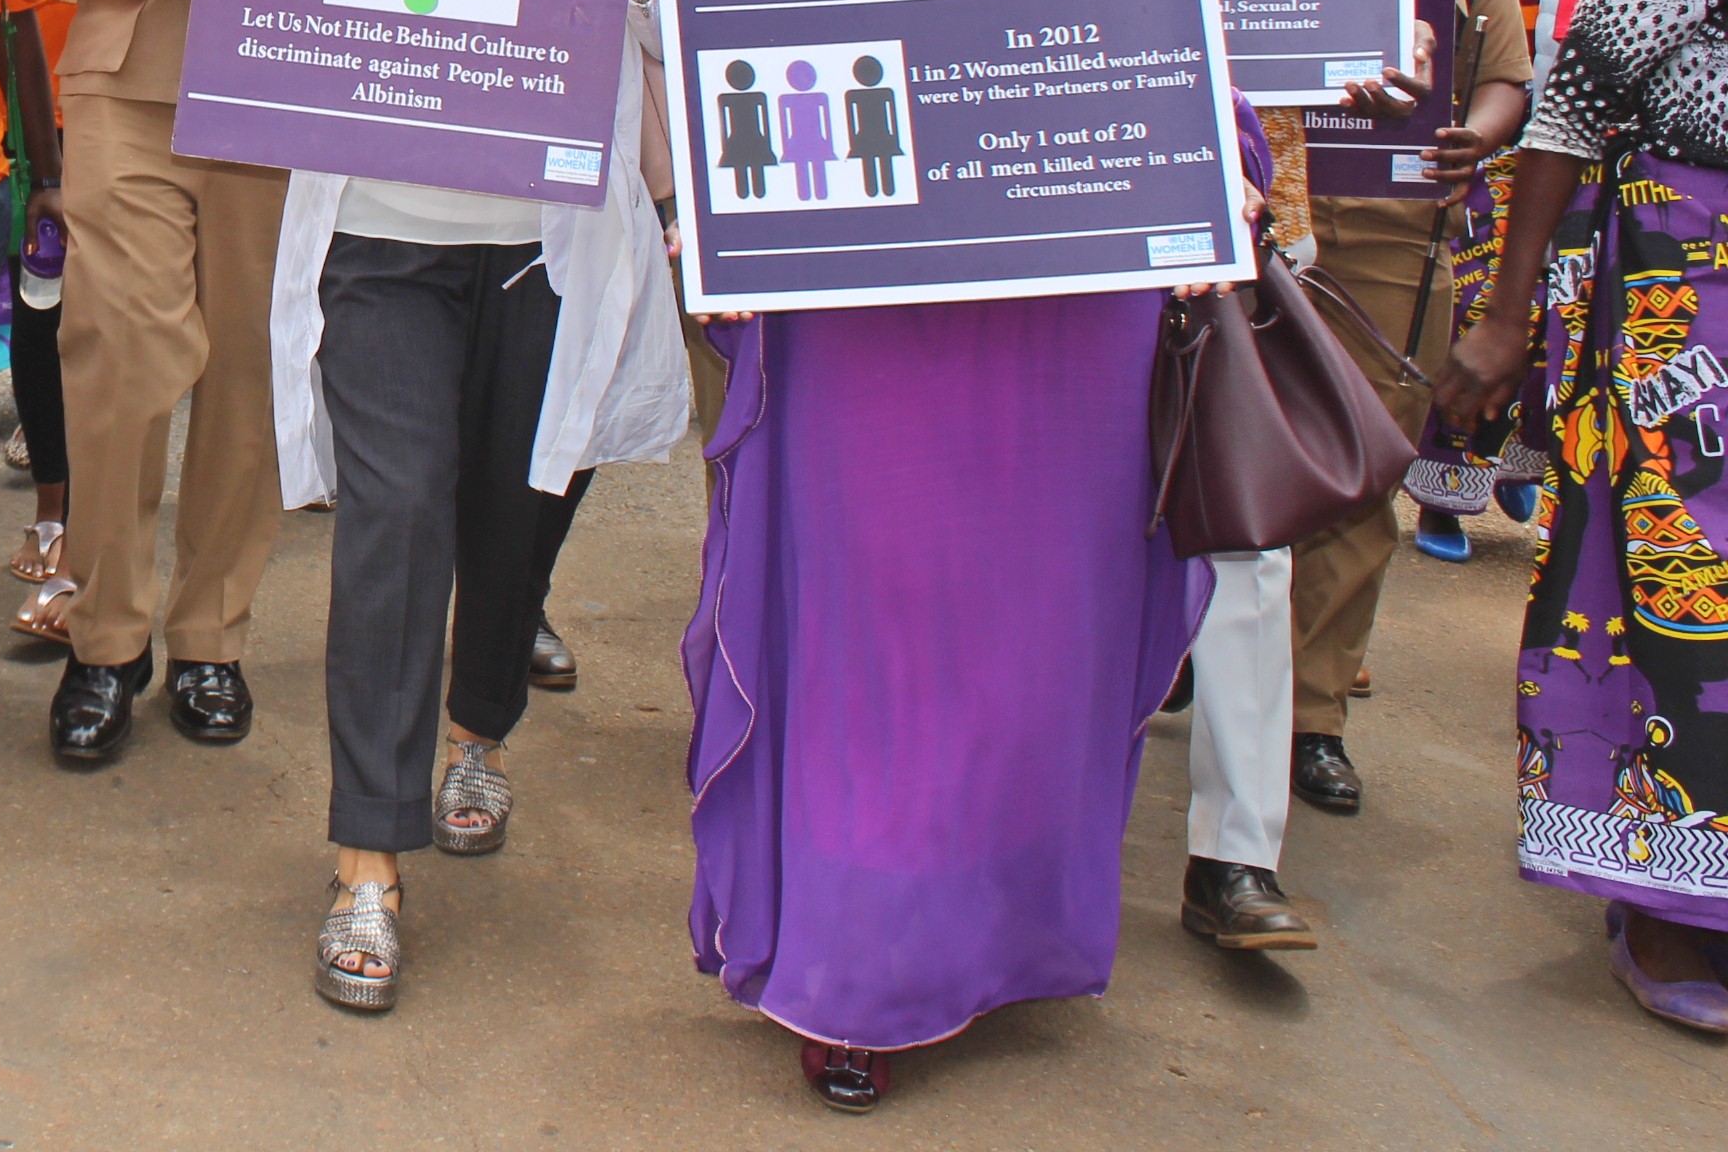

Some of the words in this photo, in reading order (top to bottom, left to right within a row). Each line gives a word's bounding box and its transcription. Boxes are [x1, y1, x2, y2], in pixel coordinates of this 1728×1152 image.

[1237, 0, 1298, 12] Sexual
[1299, 2, 1321, 11] or
[241, 7, 274, 29] Let
[278, 12, 303, 33] Us
[304, 14, 341, 37] Not
[343, 18, 393, 43] Hide
[396, 26, 467, 52] Behind
[470, 35, 546, 61] Culture
[549, 46, 569, 63] to
[1005, 28, 1034, 50] In
[1038, 23, 1100, 46] 2012
[1240, 18, 1320, 30] Intimate
[238, 38, 362, 70] discriminate
[368, 58, 440, 81] against
[447, 63, 514, 92] People
[520, 71, 566, 94] with
[910, 65, 919, 83] 1
[923, 64, 946, 82] in
[948, 63, 961, 80] 2
[963, 57, 1044, 80] Women
[1044, 52, 1106, 75] killed
[1107, 47, 1201, 70] worldwide
[351, 82, 443, 111] Albinism
[918, 90, 958, 104] were
[962, 86, 982, 106] by
[987, 82, 1029, 100] their
[1034, 77, 1108, 98] Partners
[1112, 79, 1132, 92] or
[1136, 70, 1197, 92] Family
[1303, 111, 1373, 130] lbinism
[978, 130, 1031, 154] Only
[1036, 130, 1048, 147] 1
[1053, 126, 1090, 146] out
[1094, 123, 1118, 143] of
[1120, 122, 1146, 141] 20
[548, 158, 585, 170] WOMEN
[927, 162, 949, 182] of
[956, 158, 984, 180] all
[990, 160, 1037, 178] men
[1042, 153, 1094, 174] killed
[1100, 153, 1142, 170] were
[1148, 149, 1167, 166] in
[1172, 146, 1214, 166] such
[1006, 176, 1130, 200] circumstances
[1151, 244, 1196, 254] WOMEN
